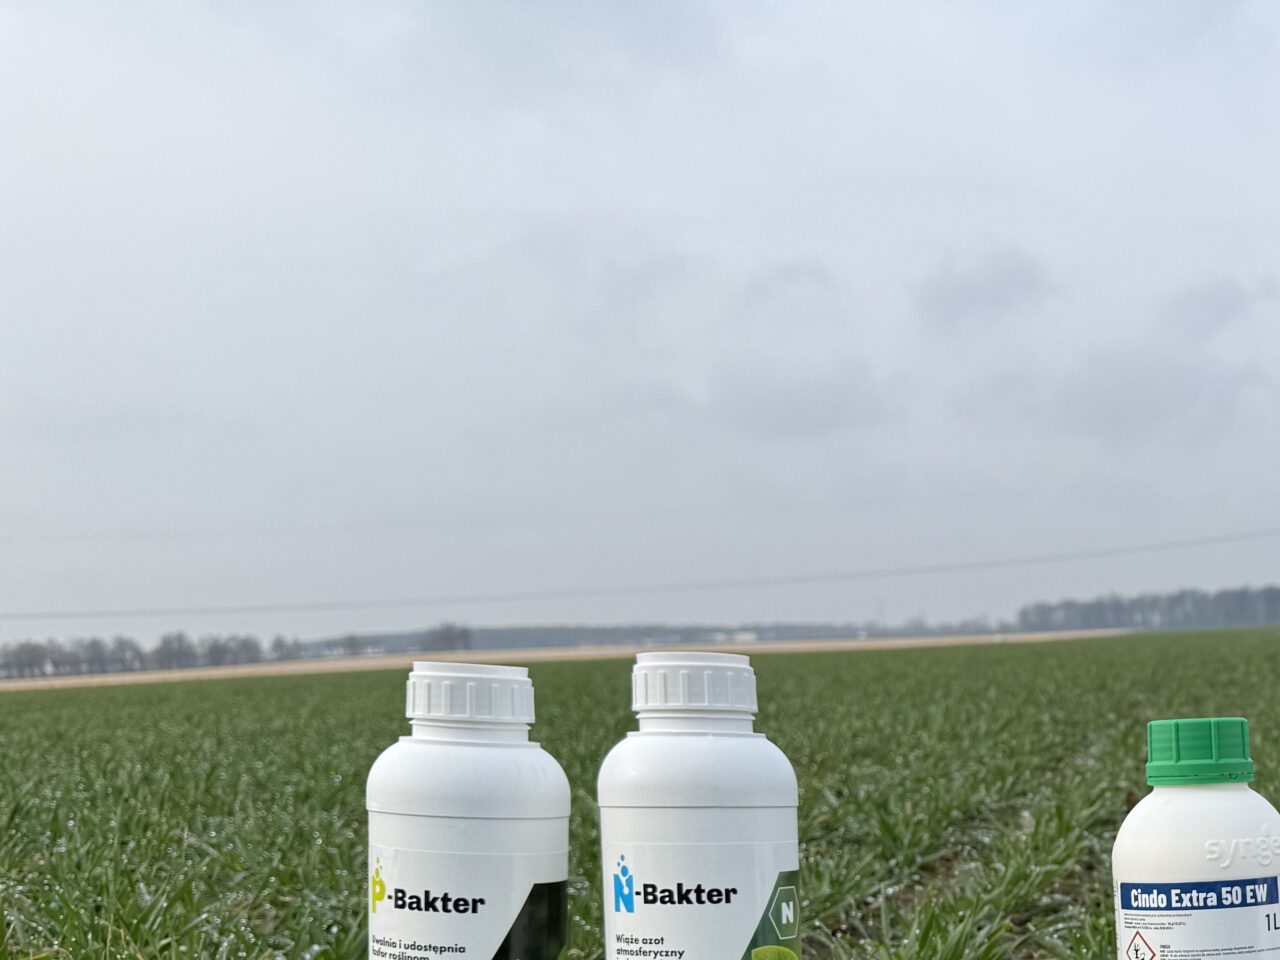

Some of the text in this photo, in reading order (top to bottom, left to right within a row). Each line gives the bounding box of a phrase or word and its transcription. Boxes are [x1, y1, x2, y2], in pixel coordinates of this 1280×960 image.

[371, 874, 486, 914] P-Bakter
[613, 873, 738, 913] N-Bakter
[1130, 883, 1268, 908] Cindo Extra 50 EW
[781, 901, 794, 924] N
[398, 939, 403, 949] i
[404, 941, 466, 955] udostępnia
[616, 933, 665, 946] Wiąże azot
[616, 946, 685, 960] atmosferyczny
